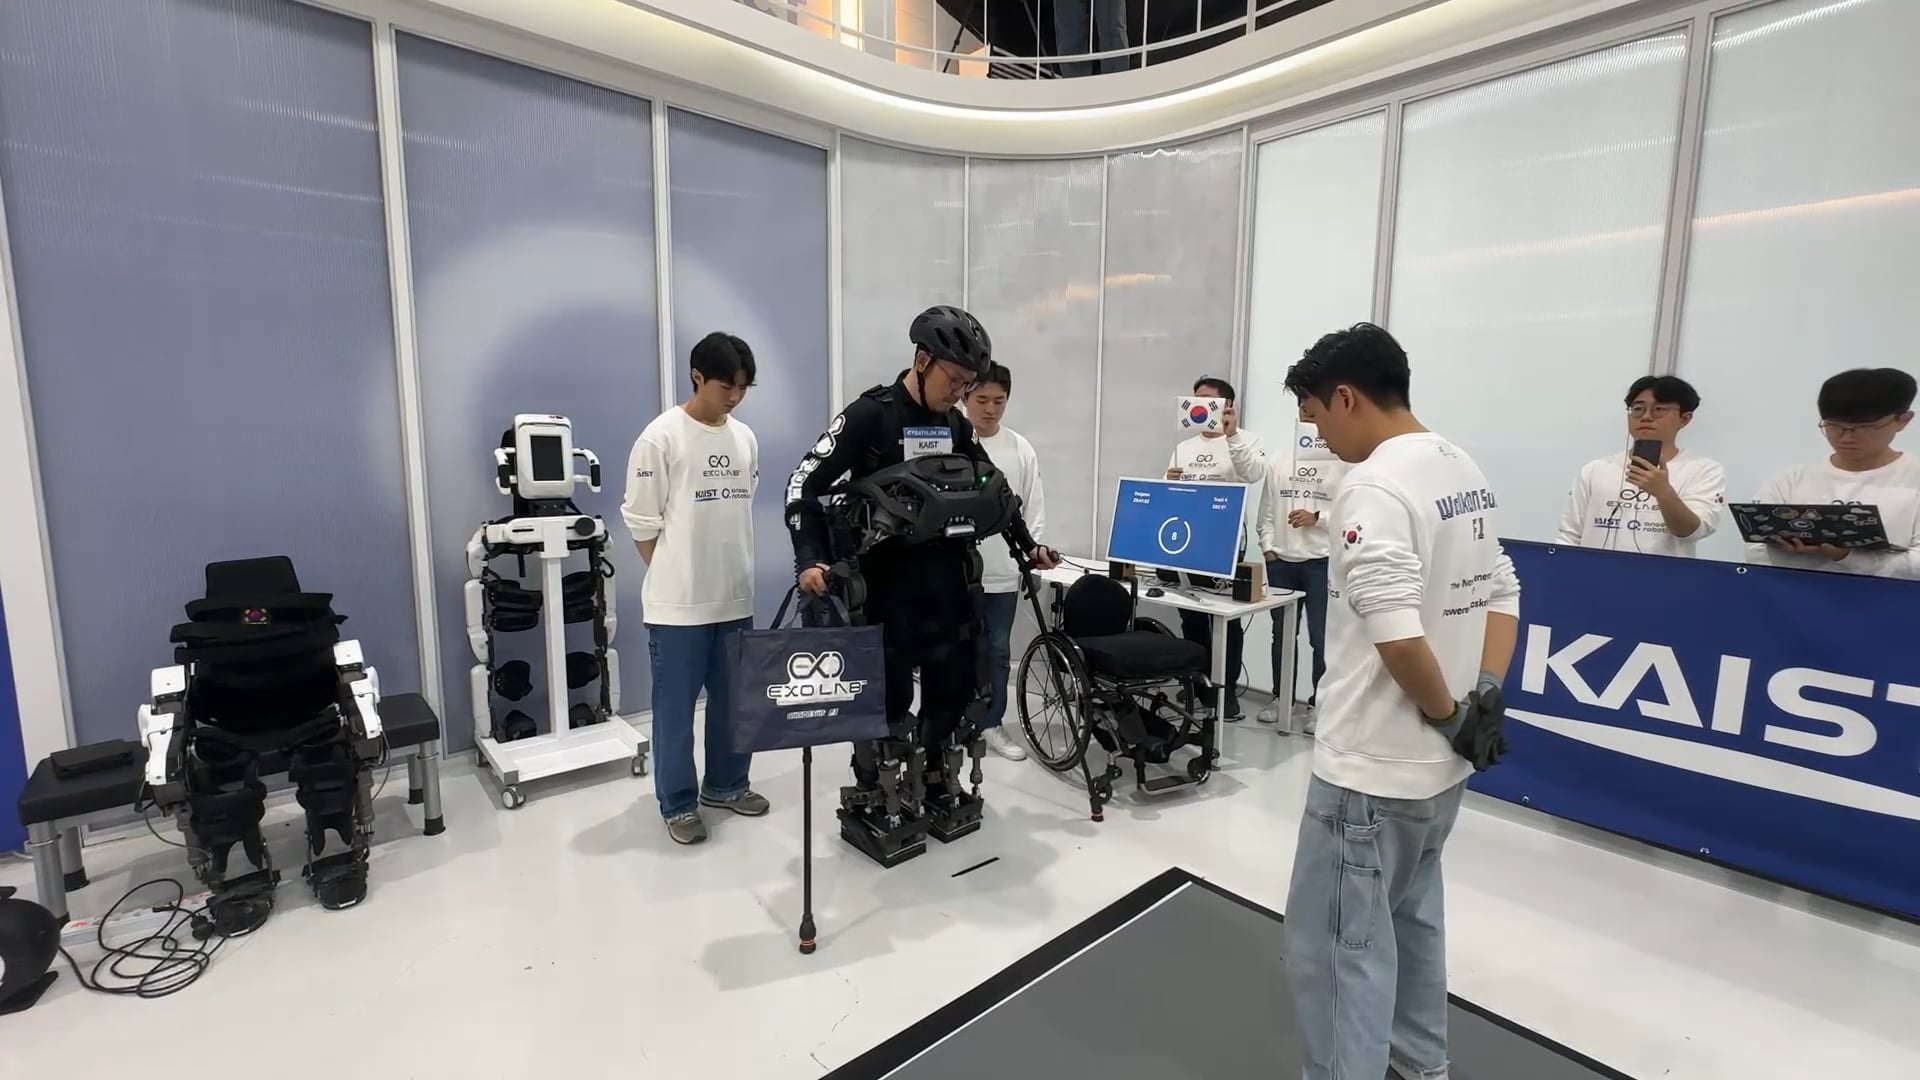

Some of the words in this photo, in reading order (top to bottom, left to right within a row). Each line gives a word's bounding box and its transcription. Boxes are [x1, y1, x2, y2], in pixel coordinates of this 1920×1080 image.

[918, 440, 939, 449] KAIST
[768, 685, 815, 698] EXO
[819, 681, 862, 696] LAB
